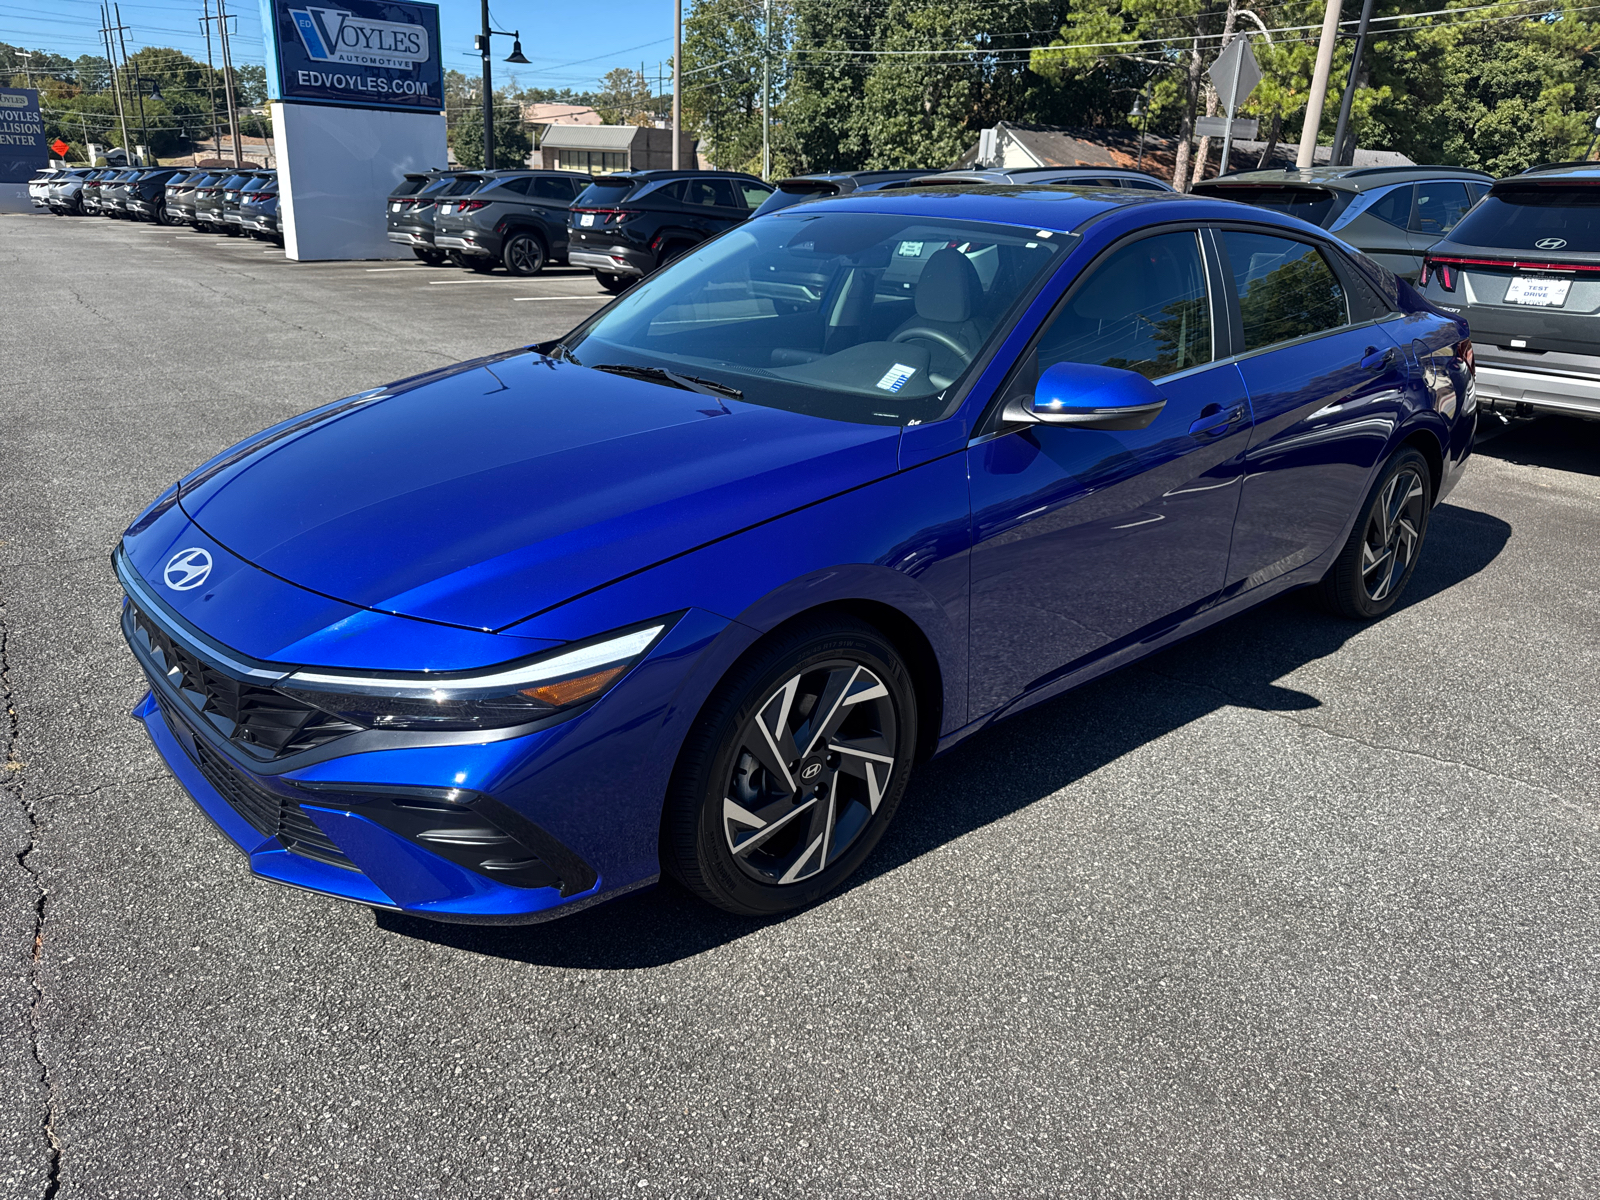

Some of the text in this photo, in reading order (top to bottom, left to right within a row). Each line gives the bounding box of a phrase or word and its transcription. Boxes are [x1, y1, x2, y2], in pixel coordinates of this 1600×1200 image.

[299, 9, 421, 55] ED VOYLES
[338, 54, 411, 68] AUTOMOTIVE
[298, 70, 428, 95] EDVOYLES.COM
[0, 94, 26, 104] OYLES
[0, 134, 36, 146] ENTER
[822, 641, 836, 650] R17
[837, 640, 855, 648] 91W
[885, 758, 910, 821] KUMHO
